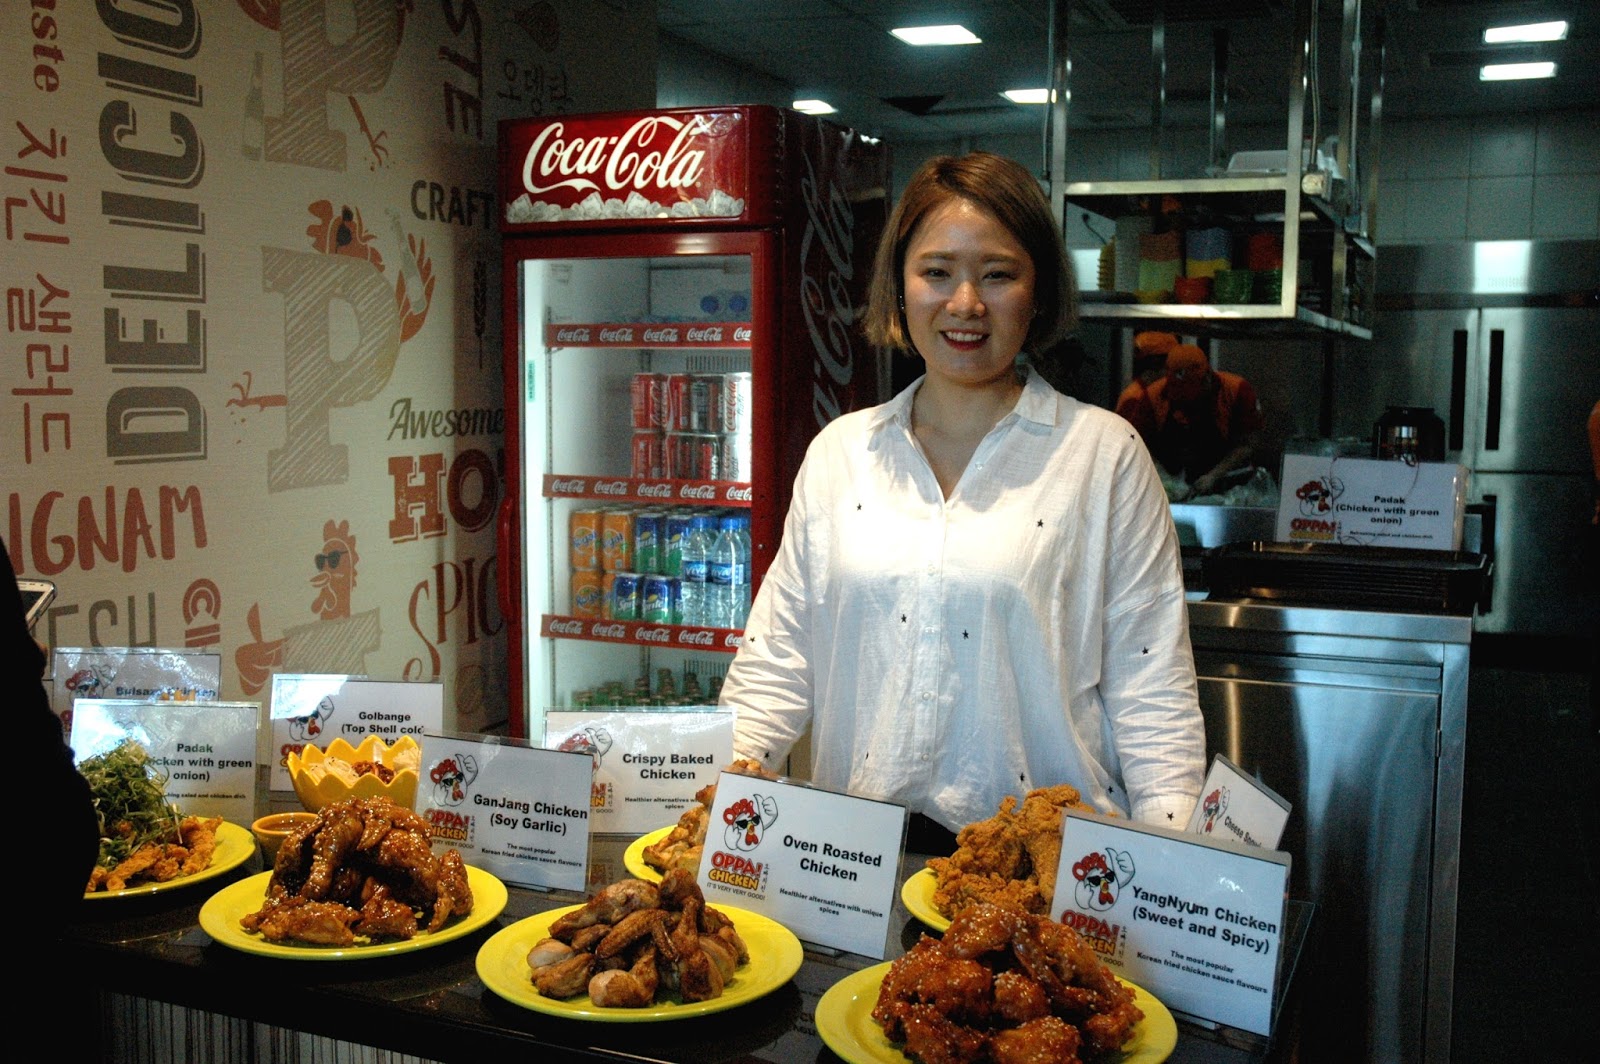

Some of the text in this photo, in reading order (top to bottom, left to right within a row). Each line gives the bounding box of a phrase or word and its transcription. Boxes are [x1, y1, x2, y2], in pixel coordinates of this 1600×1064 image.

[522, 115, 714, 194] Coca-Cola
[411, 180, 497, 230] CRAFT
[5, 120, 74, 466] 치킨 샐러드
[387, 397, 504, 441] Awesome
[388, 448, 504, 545] HO
[1374, 495, 1406, 505] Padak
[1336, 503, 1439, 517] (Chicken with green
[1370, 516, 1403, 526] onion)
[359, 711, 411, 723] Golbange
[341, 724, 366, 735] (Top
[369, 724, 396, 734] Shell
[177, 743, 213, 753] Padak
[622, 753, 714, 766] Crispy Baked
[152, 756, 252, 769] icken with green
[640, 769, 696, 779] Chicken
[173, 771, 210, 781] onion)
[473, 793, 588, 819] GanJang Chicken
[431, 825, 467, 841] HICKEN
[490, 813, 567, 837] (Soy Garlic)
[1224, 815, 1244, 839] Cheese
[481, 847, 501, 856] Korean
[783, 835, 882, 867] Oven Roasted
[711, 851, 763, 878] OPPA!
[800, 858, 858, 881] Chicken
[708, 868, 760, 890] CHICKEN
[717, 884, 731, 893] VERY
[732, 888, 746, 896] VERY
[780, 888, 883, 918] Healthier alternatives with unique
[819, 906, 840, 916] spices
[1061, 909, 1120, 942] OPPA!
[1132, 905, 1270, 955] (Sweet and Spicy)
[1214, 907, 1277, 934] Chicken
[1136, 951, 1268, 994] Korean fried chicken sauce flavours
[1171, 950, 1234, 973] The most popular
